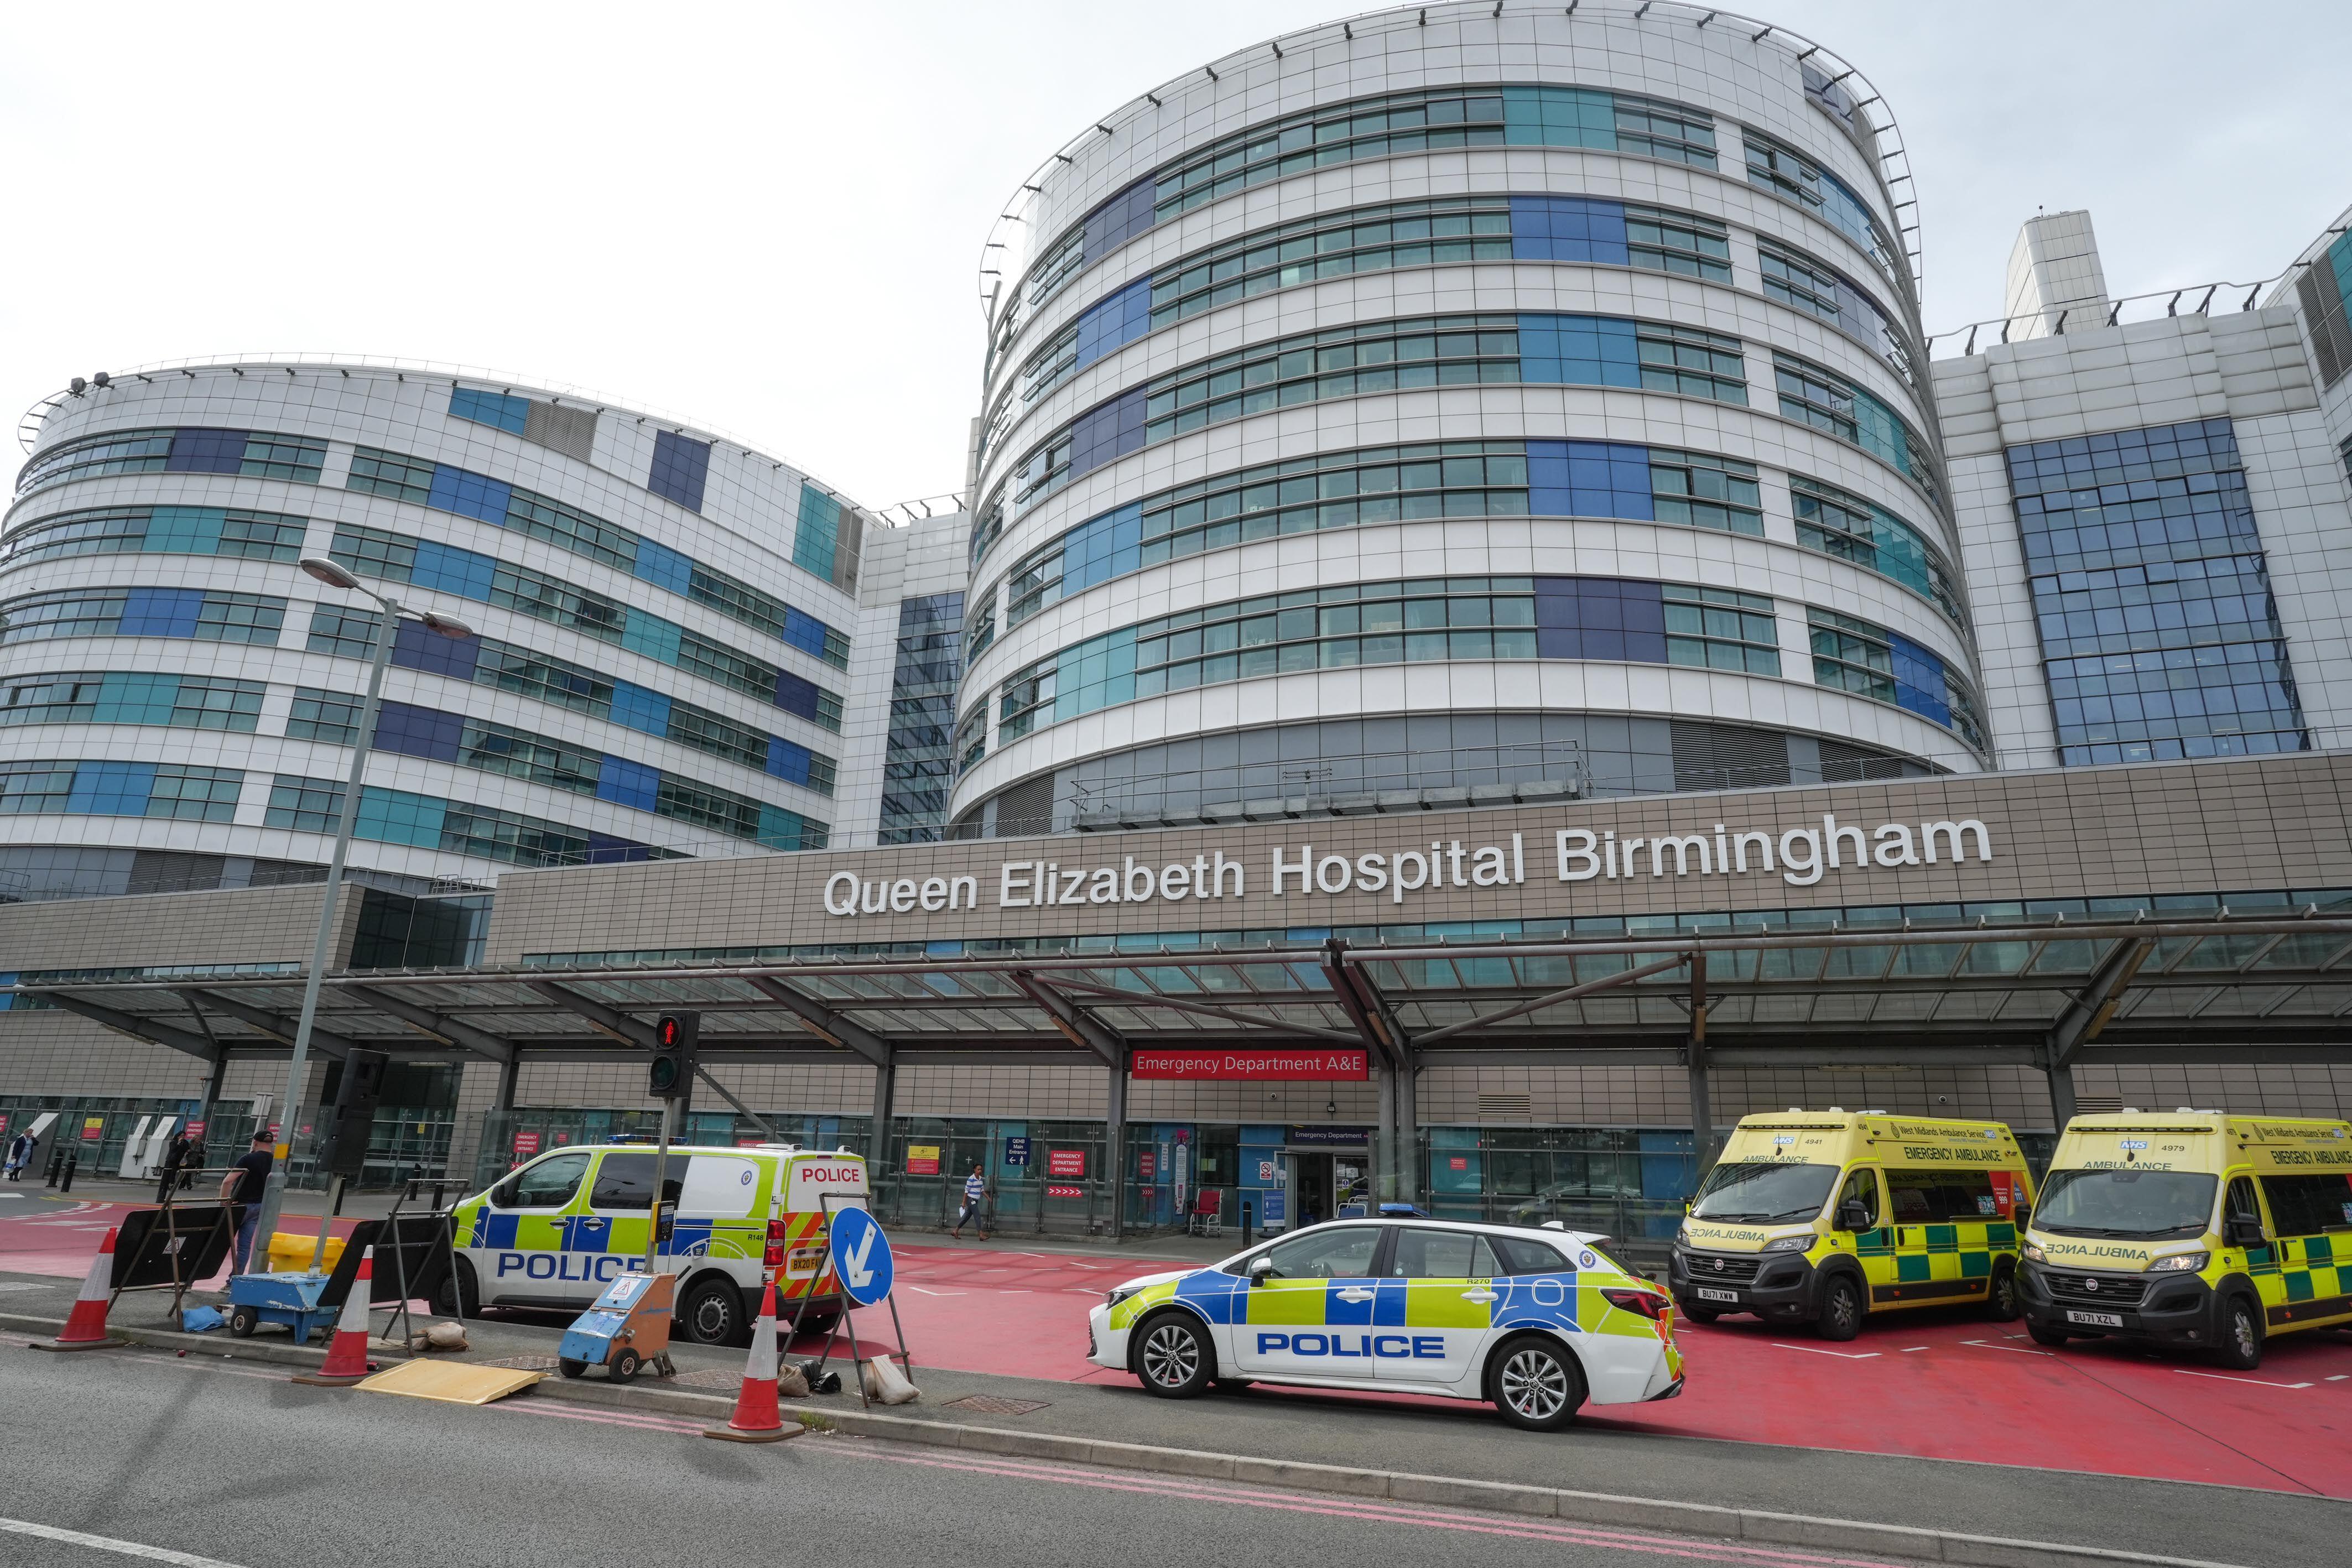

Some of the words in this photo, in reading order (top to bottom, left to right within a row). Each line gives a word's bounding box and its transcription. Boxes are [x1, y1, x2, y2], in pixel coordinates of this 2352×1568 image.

[824, 871, 977, 916] Queen
[1000, 851, 1244, 907] Elizabeth
[1273, 833, 1524, 904] Hospital
[1556, 815, 1991, 885] Birmingham
[1137, 1056, 1219, 1073] Emergency
[1225, 1056, 1320, 1074] Department
[1326, 1056, 1361, 1070] A&E
[1899, 1126, 1914, 1135] West
[1914, 1126, 1939, 1136] Midlands
[1939, 1128, 1967, 1137] Ambulance
[1967, 1129, 1986, 1138] Service
[2261, 1128, 2274, 1137] West
[2273, 1128, 2296, 1137] Midlands
[2294, 1128, 2320, 1138] Ambulance
[2318, 1129, 2335, 1138] Service
[1742, 1155, 1809, 1164] AMBULANCE
[1904, 1147, 1953, 1160] EMERGENCY
[1955, 1148, 2002, 1161] AMBULANCE
[2270, 1150, 2314, 1164] EMERGENCY
[2083, 1161, 2172, 1170] AMBULANCE
[803, 1168, 860, 1182] POLICE
[1999, 1196, 2008, 1204] 999
[2015, 1192, 2023, 1201] 111
[794, 1259, 810, 1269] BX20
[1703, 1290, 1718, 1299] BU71
[1719, 1291, 1733, 1300] XWW
[2073, 1312, 2094, 1323] BU71
[2096, 1315, 2115, 1325] XZL
[1257, 1333, 1445, 1359] POLICE
